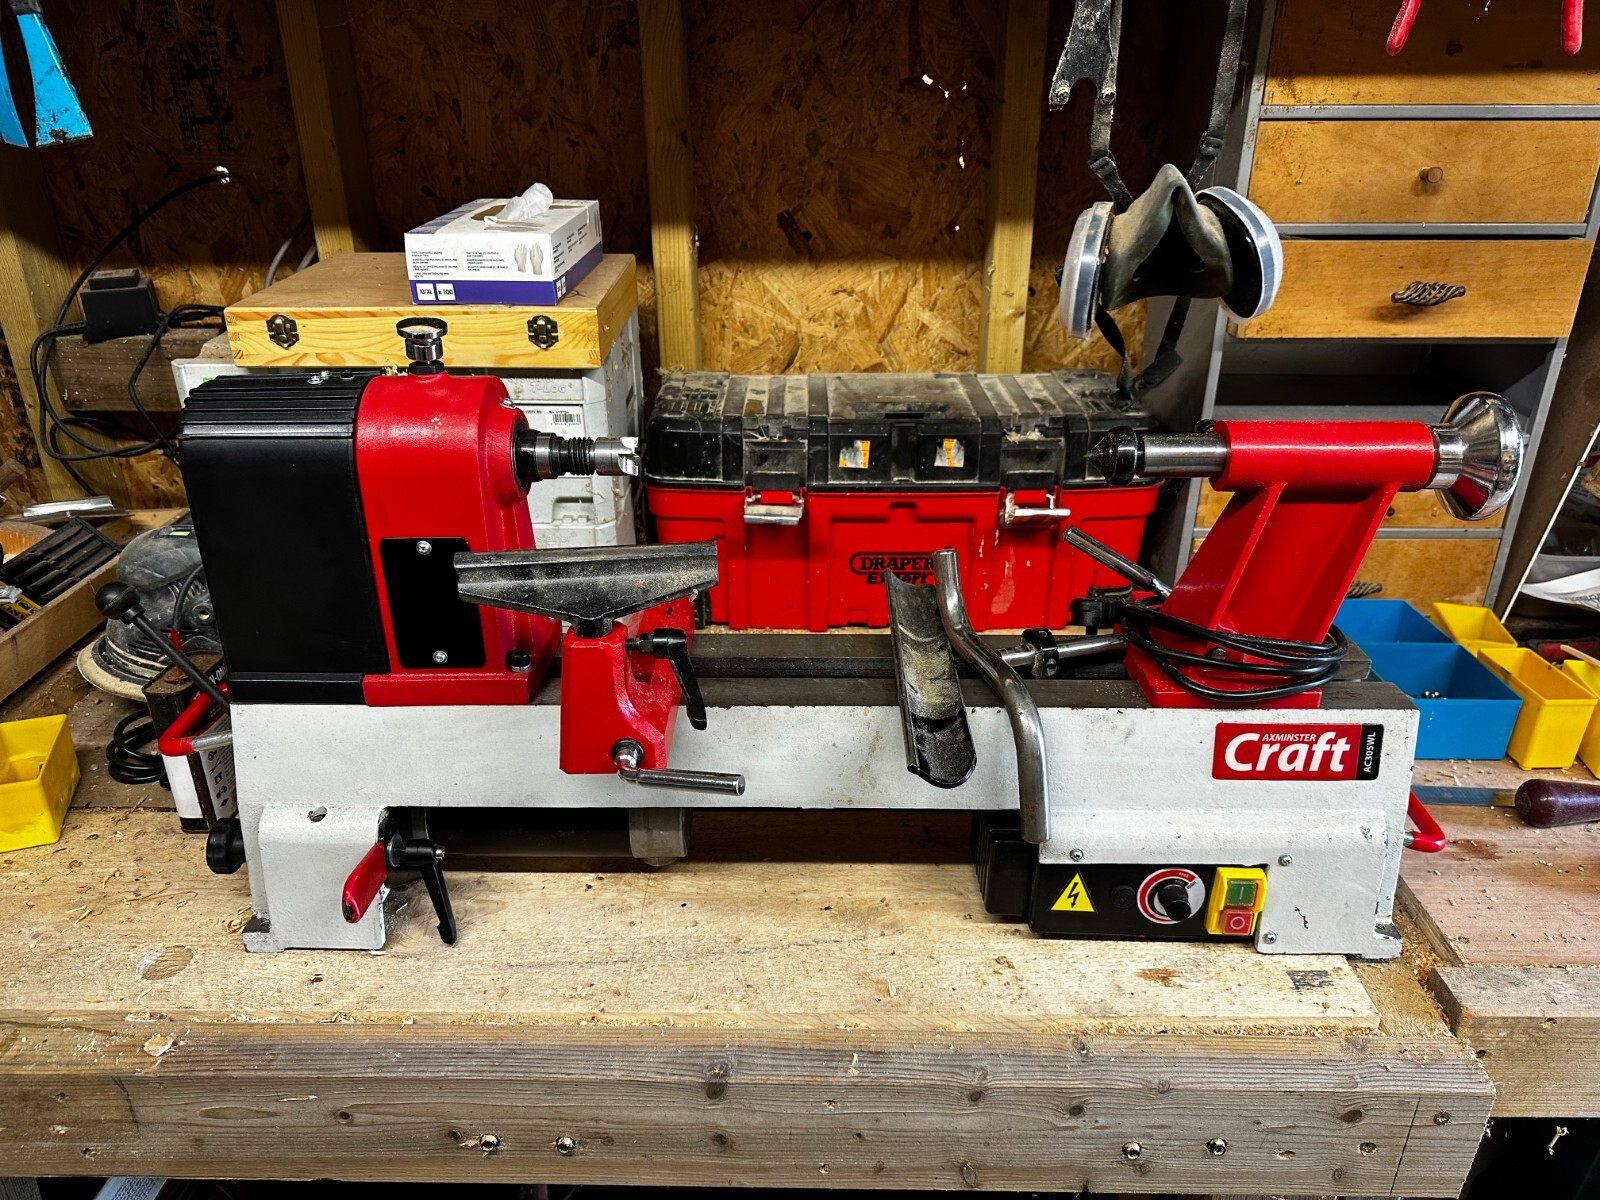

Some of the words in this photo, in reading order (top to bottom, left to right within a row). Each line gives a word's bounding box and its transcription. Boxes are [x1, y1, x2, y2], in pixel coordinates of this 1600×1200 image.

[861, 557, 934, 570] DRAPER
[866, 572, 928, 585] Eert
[1262, 733, 1317, 742] AXMINSTER
[1224, 731, 1351, 772] Craft
[1363, 731, 1377, 773] AC305WL
